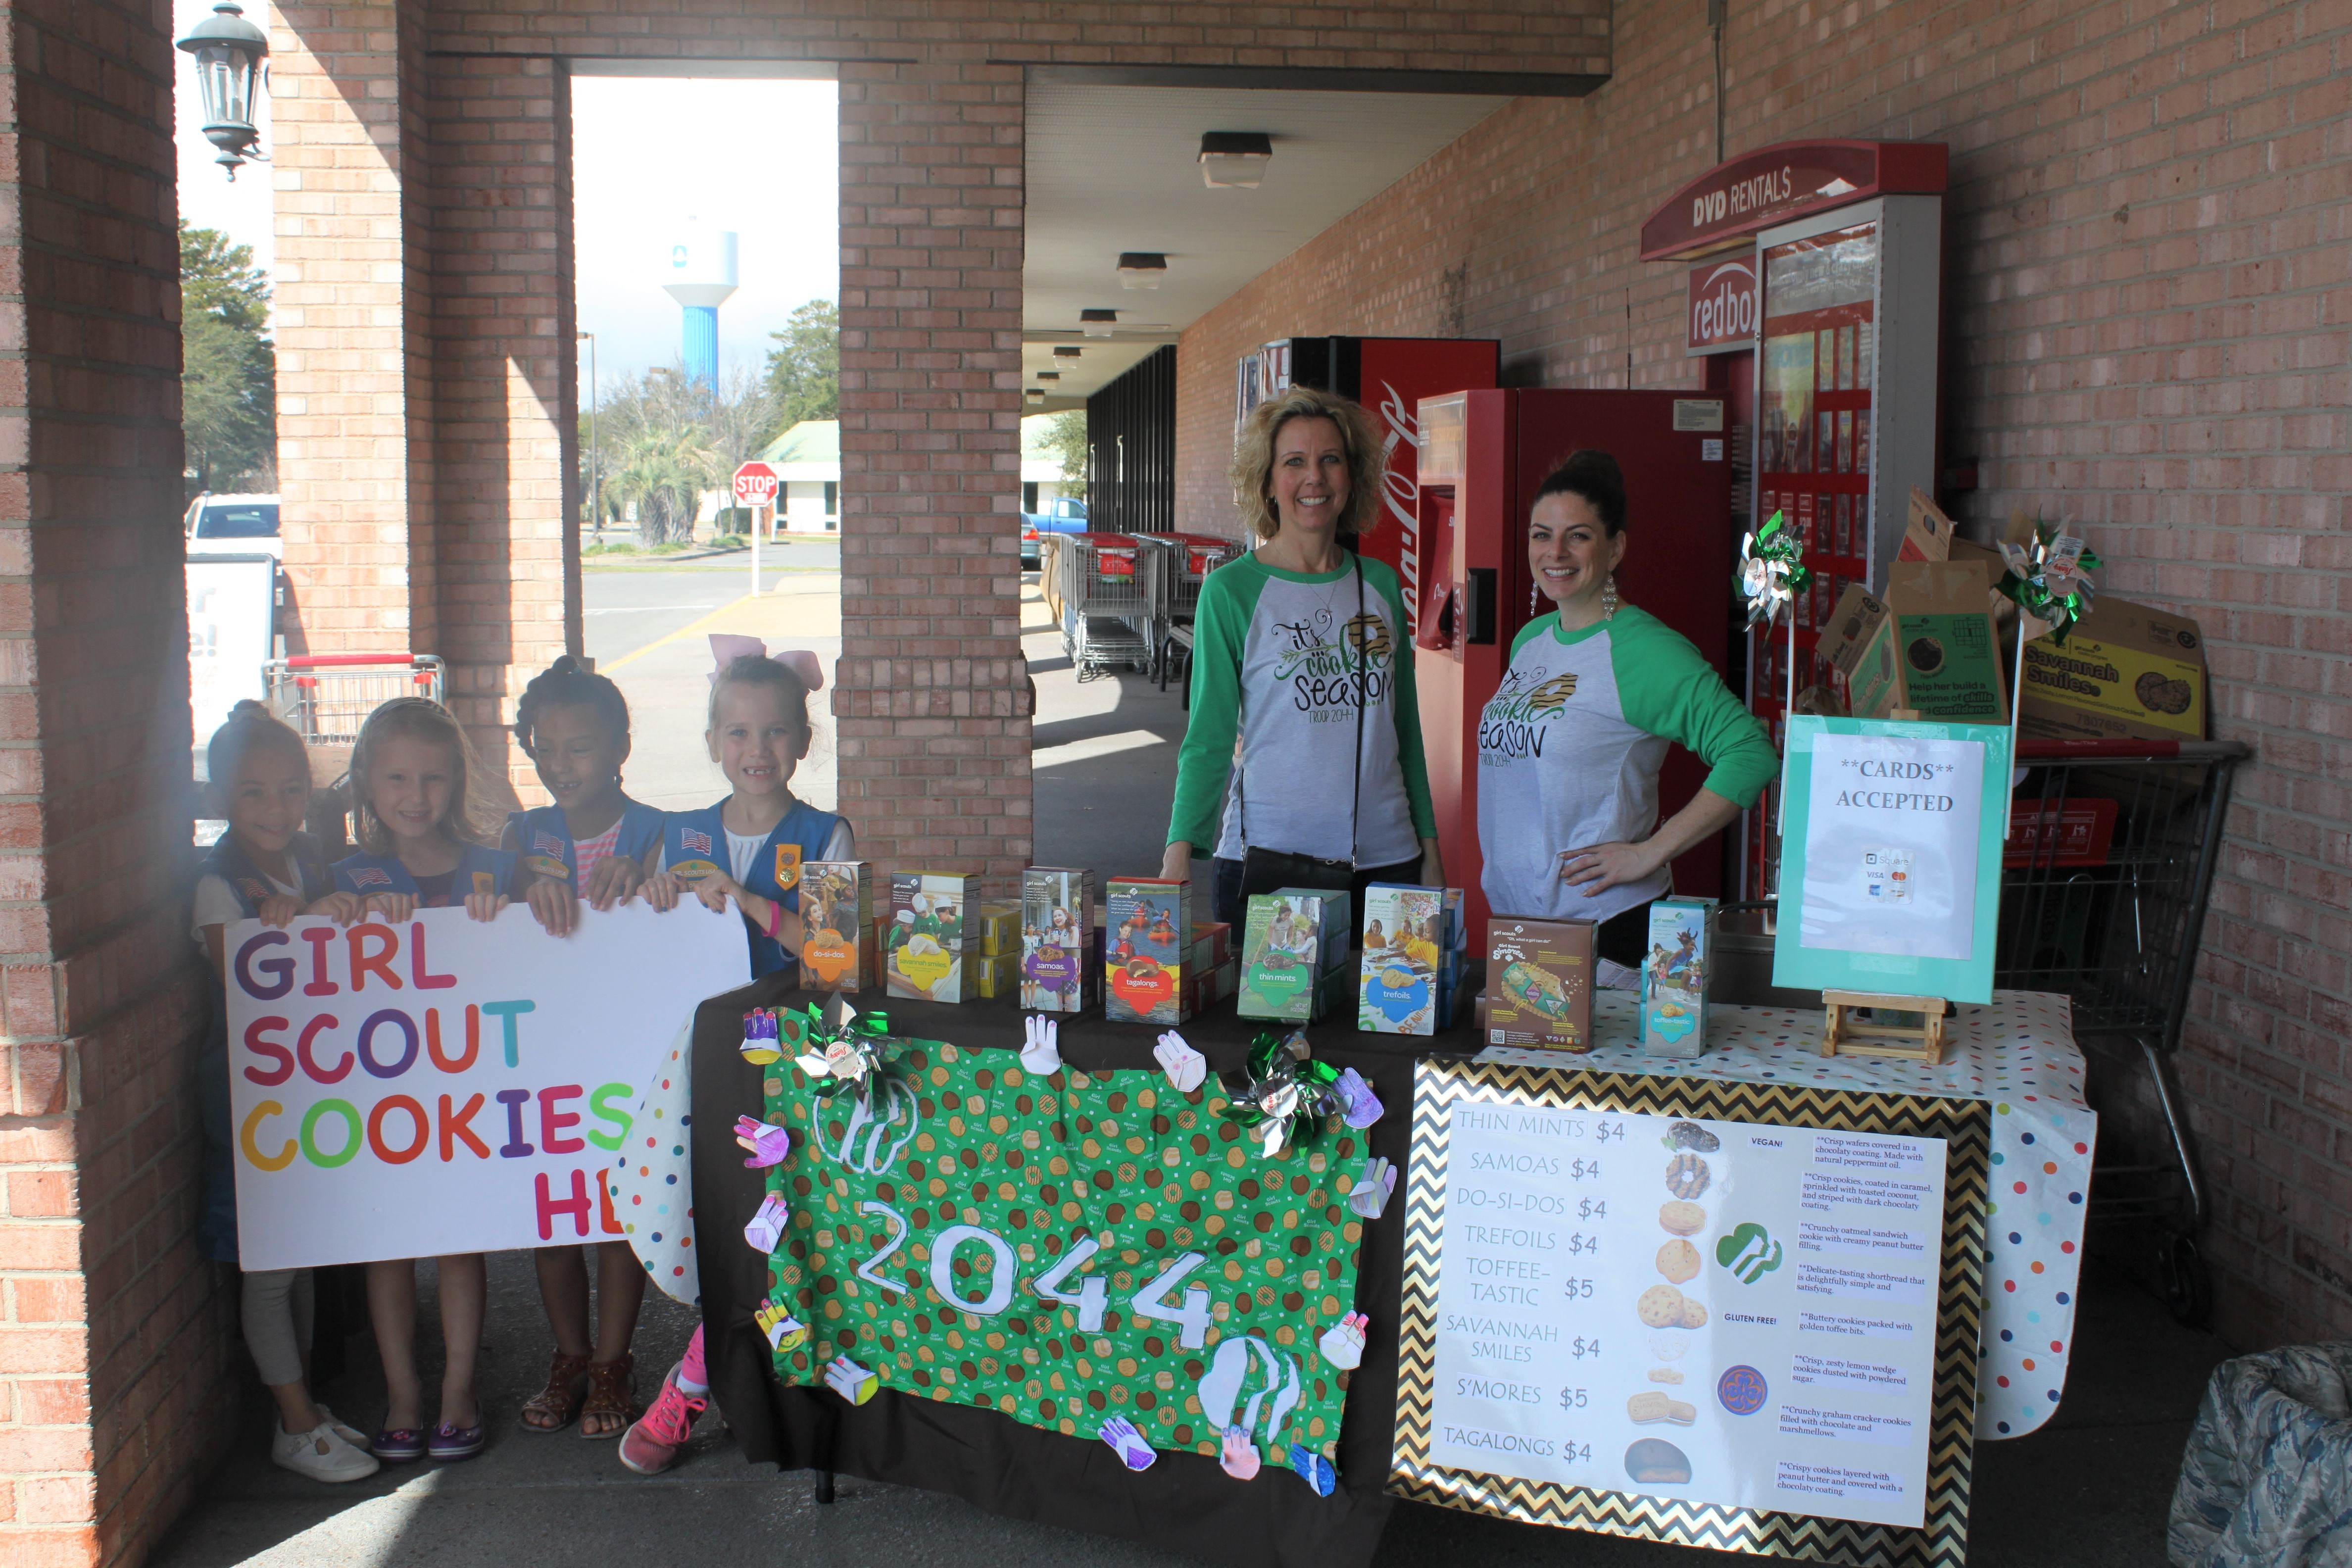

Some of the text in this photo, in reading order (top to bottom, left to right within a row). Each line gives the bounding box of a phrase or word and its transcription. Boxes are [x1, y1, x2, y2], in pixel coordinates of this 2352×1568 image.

[1693, 165, 1791, 227] DVD RENTALS
[1694, 281, 1757, 341] redbo
[737, 476, 776, 492] STOP
[2024, 645, 2119, 683] Savannah
[1909, 683, 1932, 692] Help
[1910, 694, 1949, 703] lifetime
[1963, 691, 1994, 702] skills
[1308, 708, 1354, 724] TROOP 2044
[1932, 704, 1997, 716] confidence.
[1835, 790, 1953, 812] ACCEPTED
[1879, 855, 1909, 867] Square
[1866, 871, 1884, 879] VISA
[234, 922, 457, 1001] GIRL
[899, 958, 927, 967] savannah
[1127, 979, 1158, 988] tagalongs
[1383, 990, 1411, 999] trefoils
[244, 999, 536, 1086] SCOUT
[240, 1082, 634, 1172] COOKIES
[1459, 1111, 1625, 1144] THIN MINTS $4
[1751, 1137, 1783, 1148] VEGAN!
[1815, 1146, 1851, 1157] chocolaty
[1852, 1149, 1881, 1159] coating.
[1470, 1152, 1600, 1182] SAMOAS $4
[1814, 1155, 1842, 1164] natural
[1844, 1159, 1887, 1167] peppermint
[1803, 1183, 1838, 1192] sprinkled
[1858, 1187, 1885, 1196] toasted
[1887, 1192, 1918, 1201] coconut,
[1833, 1176, 1862, 1186] cookies,
[1900, 1184, 1932, 1193] caramel,
[1457, 1188, 1607, 1221] DO-SI-DOS $4
[1801, 1201, 1830, 1211] coating.
[1817, 1193, 1844, 1203] striped
[1883, 1200, 1918, 1211] chocolaty
[1465, 1225, 1598, 1256] TREFOILS $4
[1840, 1227, 1871, 1235] oatmeal
[1872, 1231, 1908, 1239] sandwich
[1798, 1241, 1821, 1252] filling.
[1843, 1237, 1871, 1247] creamy
[1900, 1241, 1923, 1250] butter
[1466, 1257, 1550, 1279] TOFFEE-
[856, 1200, 1213, 1352] 2044
[1805, 1274, 1848, 1287] delightfully
[1850, 1280, 1875, 1289] simple
[1866, 1272, 1908, 1282] shortbread
[1470, 1276, 1593, 1307] TASTIC $5
[1796, 1283, 1833, 1295] satisfying.
[1724, 1313, 1776, 1325] GLUTEN FREE!
[1837, 1317, 1865, 1325] cookies
[1446, 1315, 1558, 1342] SAVANNAH
[1826, 1324, 1848, 1333] toffee
[1471, 1336, 1601, 1363] SMILES $4
[1826, 1360, 1845, 1369] zesty
[1846, 1361, 1870, 1370] lemon
[1872, 1366, 1896, 1375] wedge
[1822, 1368, 1848, 1377] dusted
[1868, 1375, 1906, 1384] powdered
[1457, 1378, 1588, 1411] S'MORES $5
[1780, 1415, 1799, 1423] filled
[1819, 1420, 1856, 1429] chocolate
[1779, 1426, 1835, 1437] marshmellows.
[1443, 1426, 1592, 1465] TAGALONGS $4
[1806, 1474, 1830, 1483] butter
[1843, 1469, 1870, 1478] layered
[1777, 1481, 1844, 1497] chocolaty coating.
